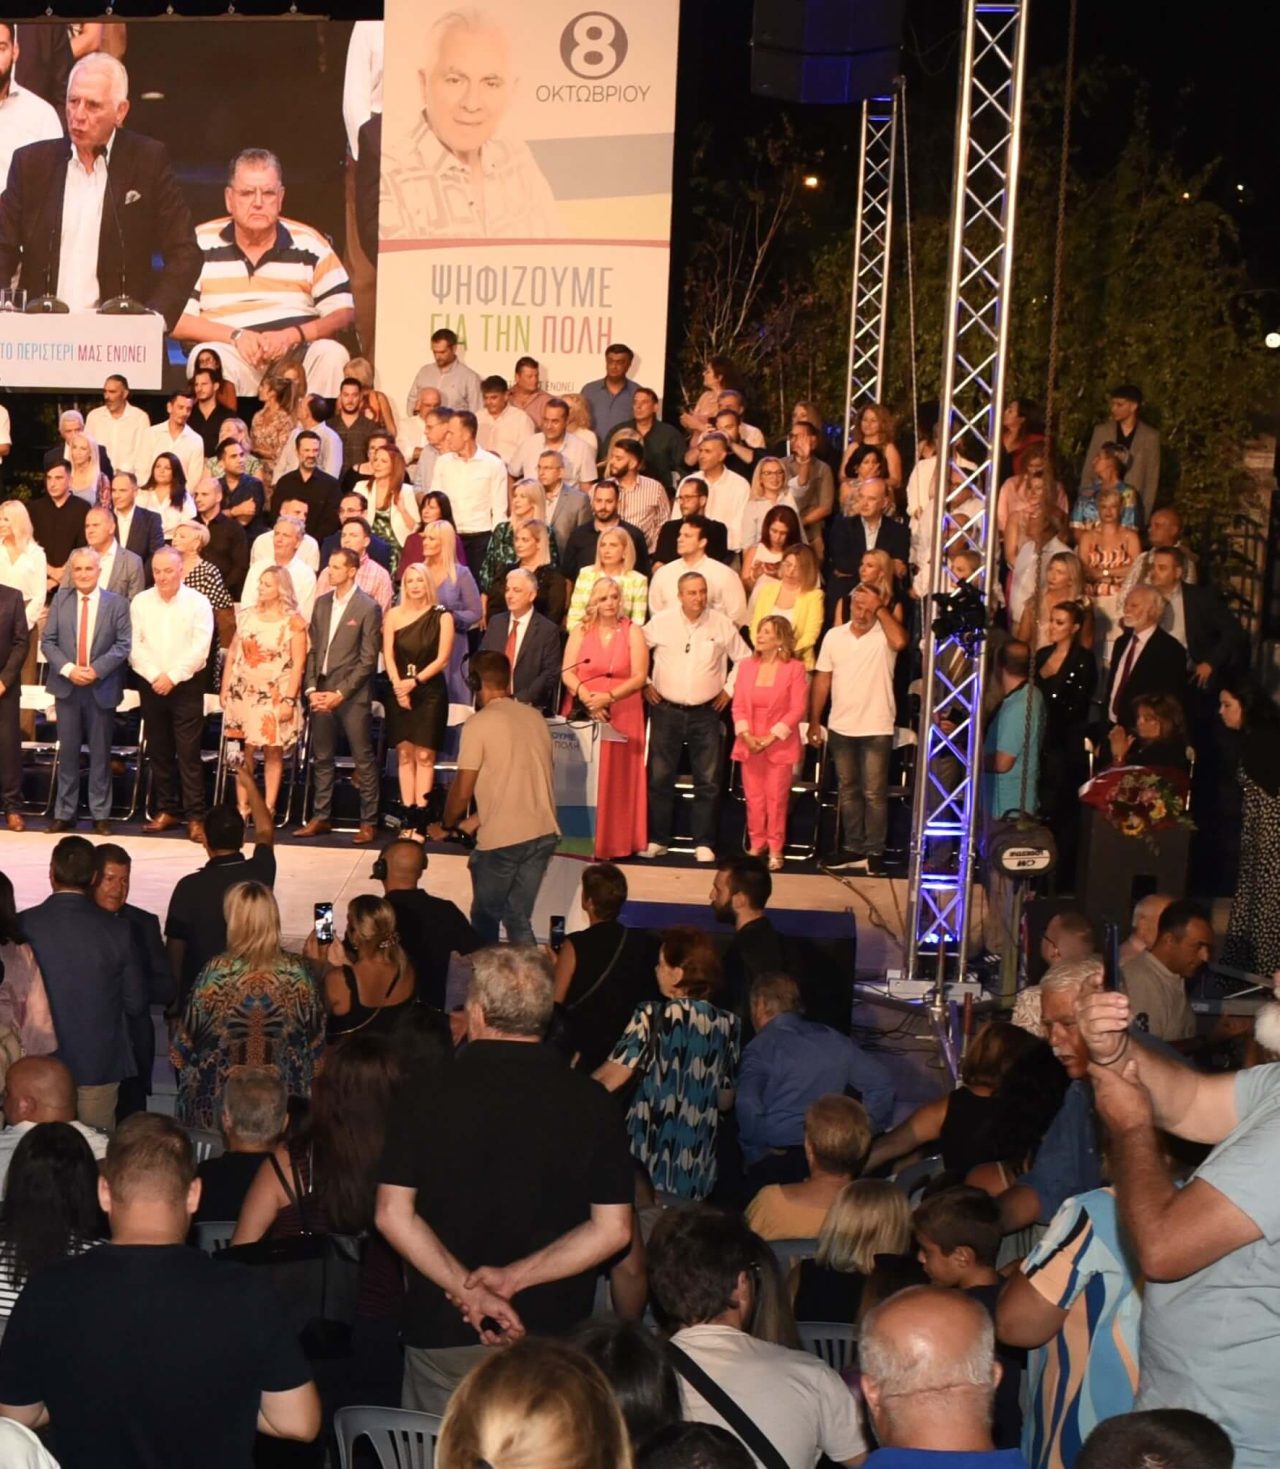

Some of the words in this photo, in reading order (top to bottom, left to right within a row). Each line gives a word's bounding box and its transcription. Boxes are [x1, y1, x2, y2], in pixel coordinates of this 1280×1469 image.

[570, 14, 617, 77] 8
[535, 84, 651, 103] ΟΚΤΩΒΡΙΟΥ
[431, 264, 614, 308] ΨΗΦΙΖΟΥΜΕ
[0, 342, 13, 361] ΤΟ
[17, 342, 74, 361] ΠΕΡΙΣΤΕΡΙ
[78, 344, 103, 362] ΜΑΣ
[480, 314, 531, 353] ΤΗΝ
[541, 315, 613, 354] ΠΟΛΗ
